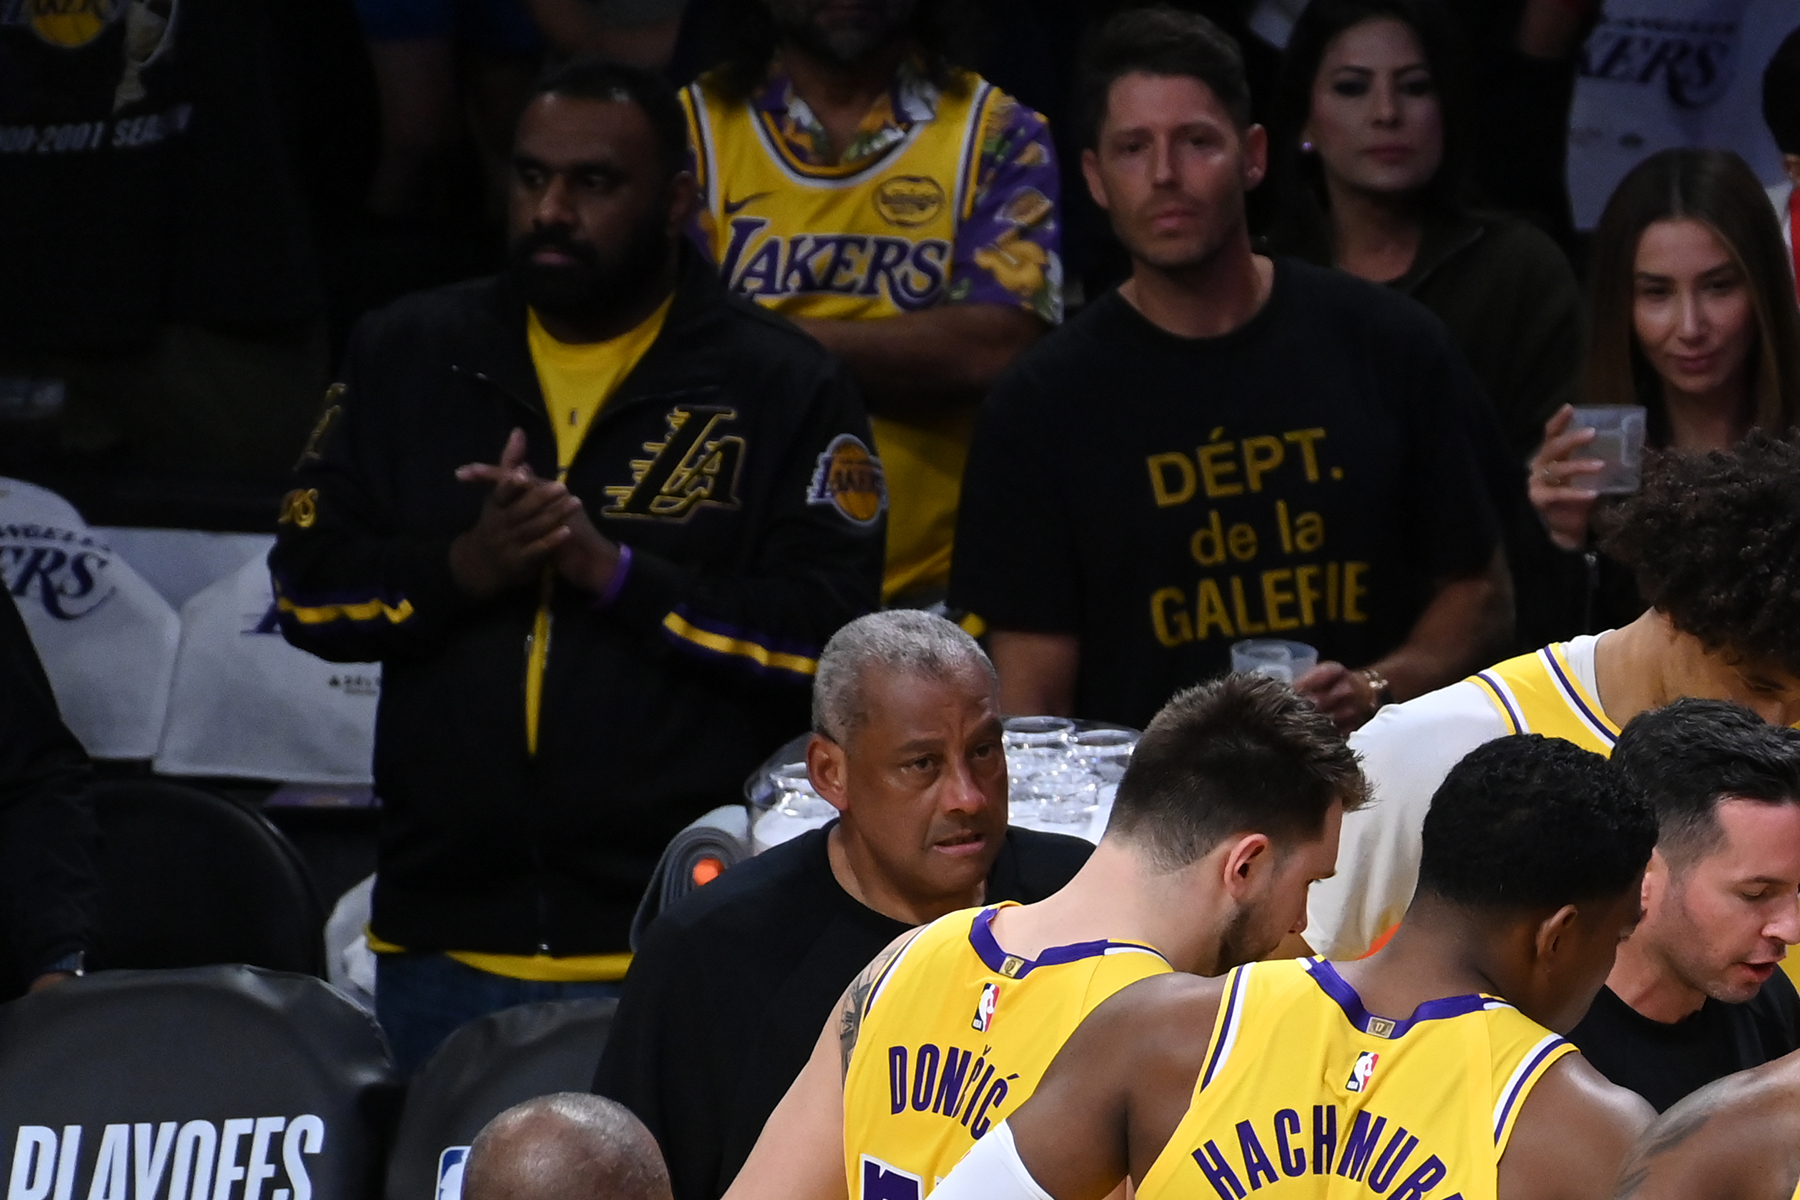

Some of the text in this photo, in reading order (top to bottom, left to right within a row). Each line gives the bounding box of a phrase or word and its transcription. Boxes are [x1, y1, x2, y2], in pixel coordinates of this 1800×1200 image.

[717, 216, 953, 314] LAKERS
[1146, 425, 1345, 508] DÉPT.
[1190, 498, 1326, 568] de la
